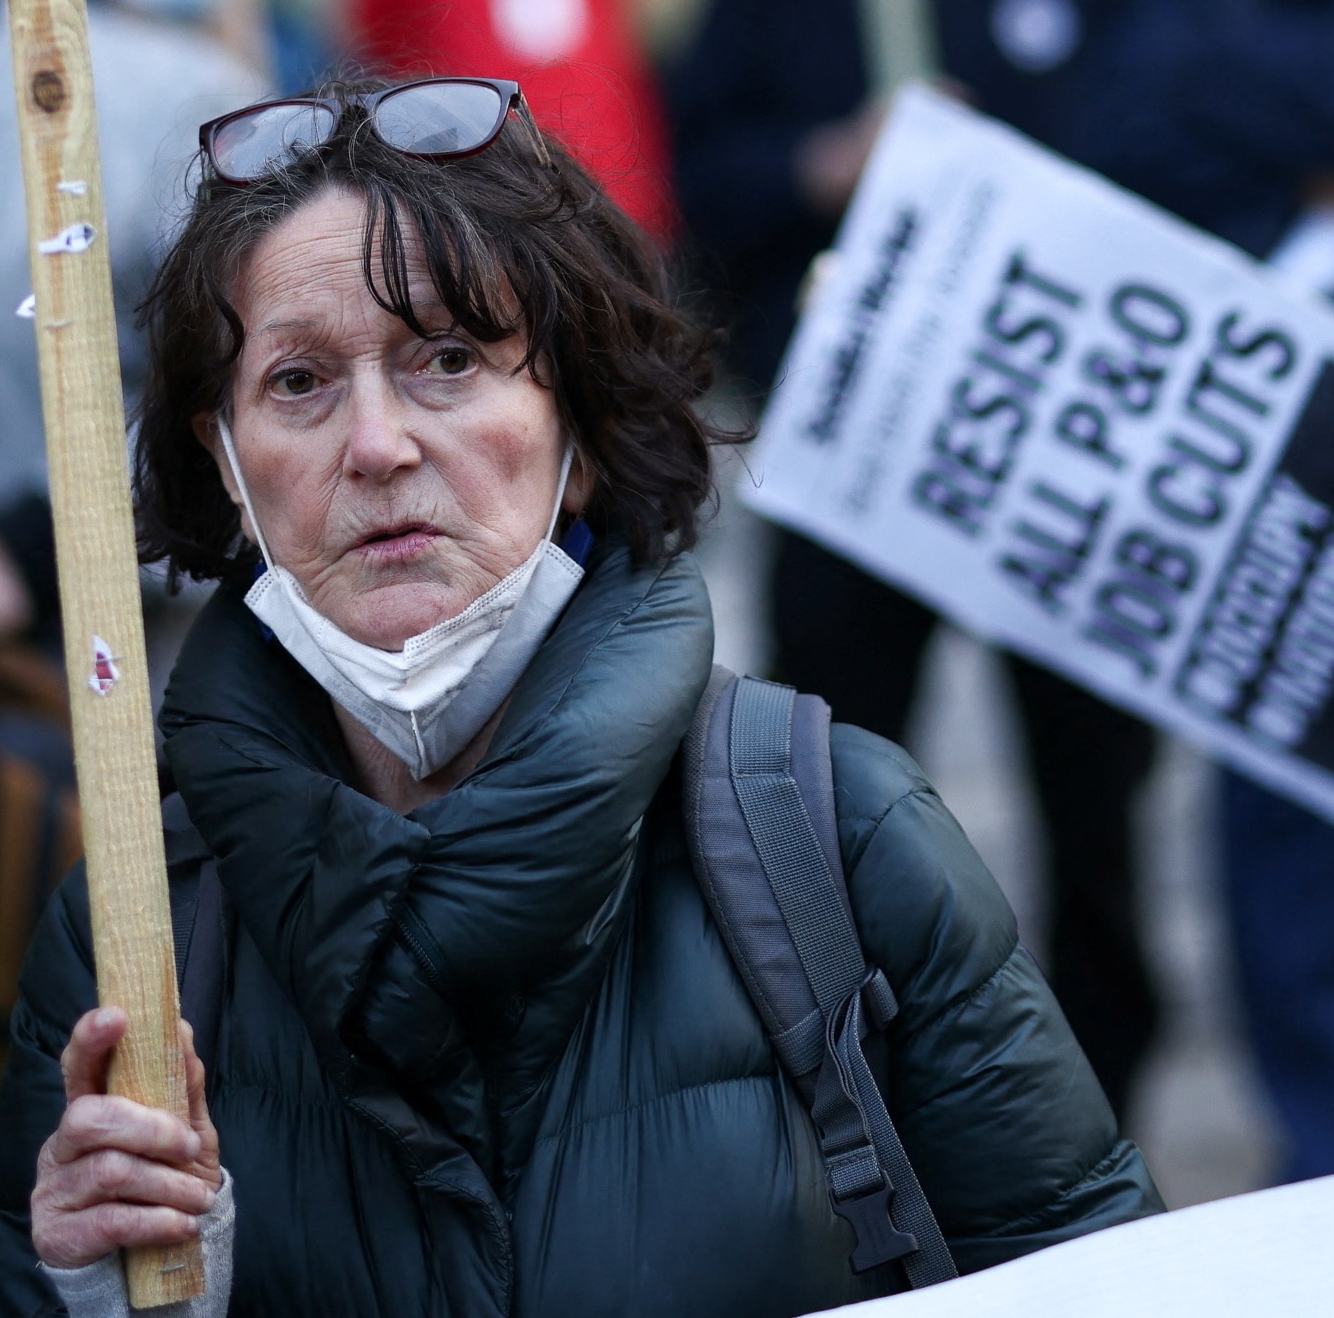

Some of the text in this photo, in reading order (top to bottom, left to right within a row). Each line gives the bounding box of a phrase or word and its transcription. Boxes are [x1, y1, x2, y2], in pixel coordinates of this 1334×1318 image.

[911, 246, 1084, 534] RESIST
[997, 282, 1192, 618] ALL P&O
[1081, 309, 1299, 680] JOB CUTS
